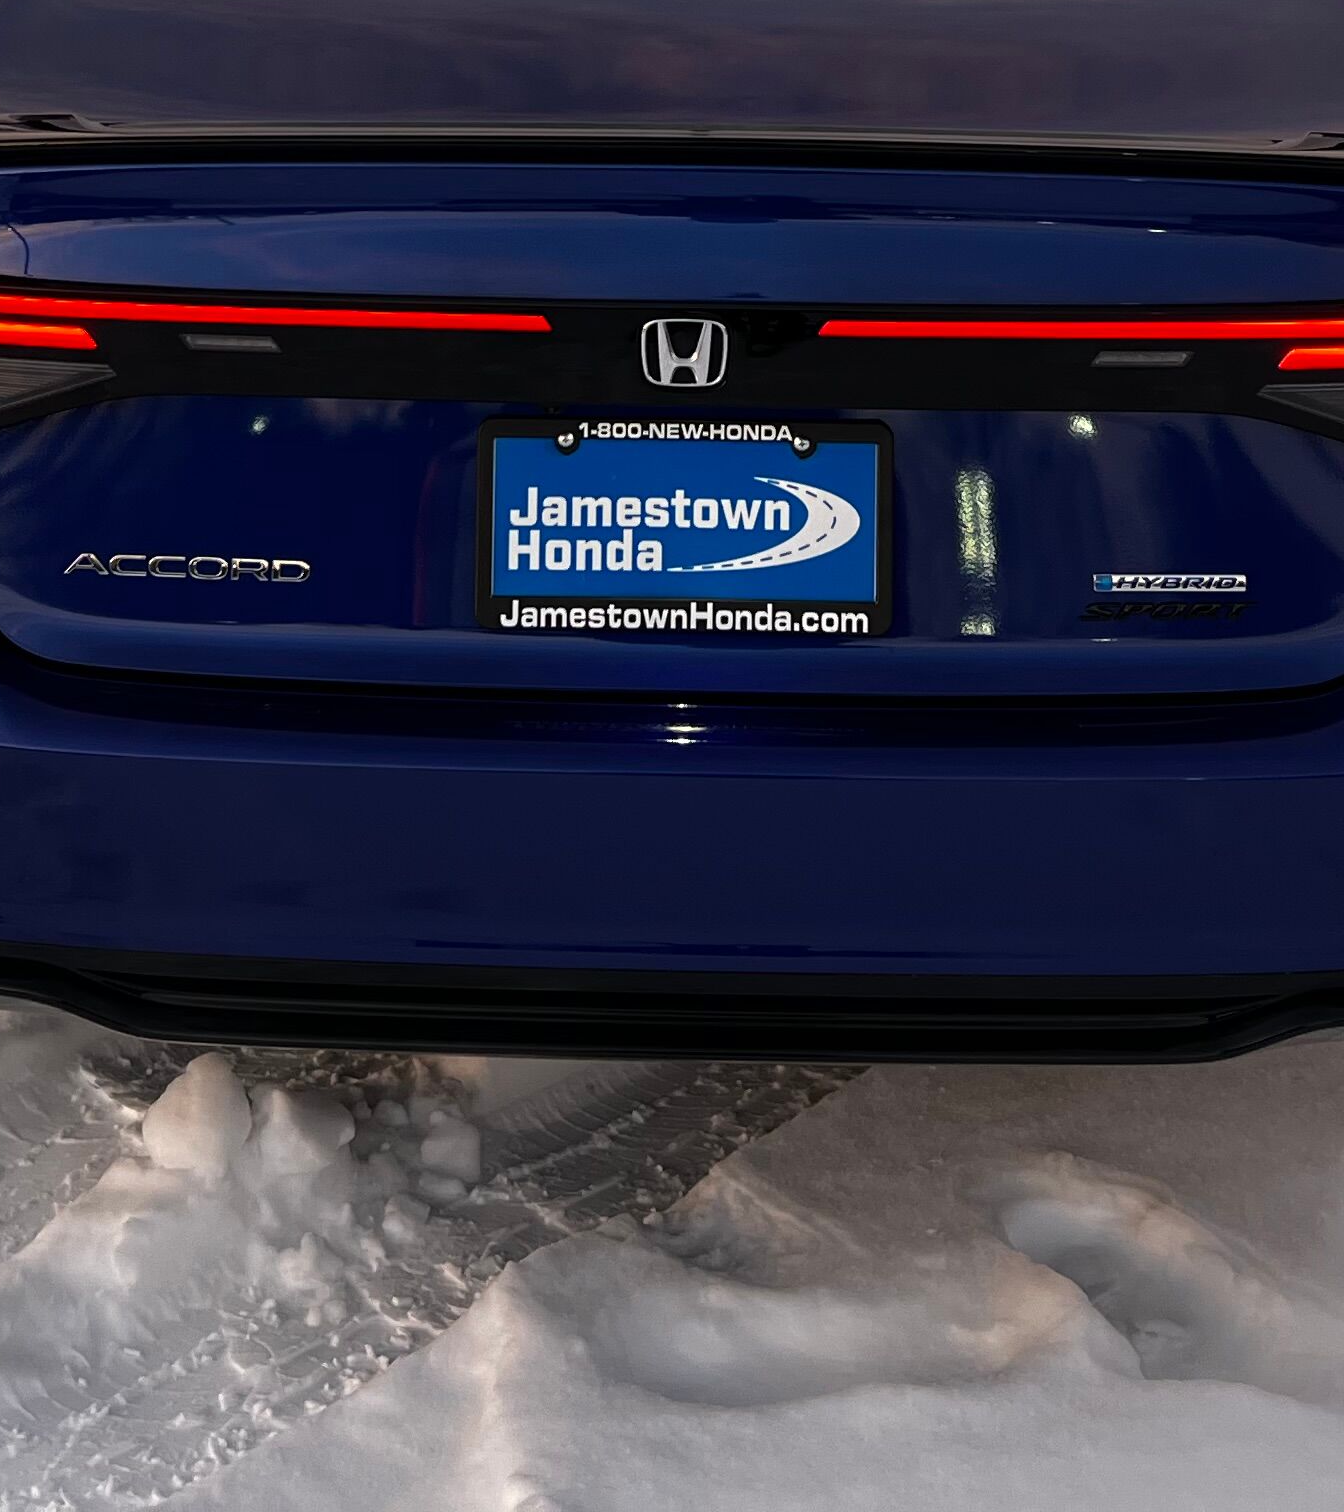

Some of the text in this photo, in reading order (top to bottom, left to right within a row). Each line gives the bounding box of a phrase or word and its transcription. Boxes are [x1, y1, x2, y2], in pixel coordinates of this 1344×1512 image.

[578, 421, 793, 443] 1-800-NEW-HONDA
[508, 486, 791, 531] Jamestown
[507, 528, 664, 572] Honda
[63, 552, 311, 583] ACCORD
[1115, 575, 1239, 590] HYBRID
[499, 599, 869, 634] JamestownHonda.com
[1079, 601, 1260, 622] SPORT
